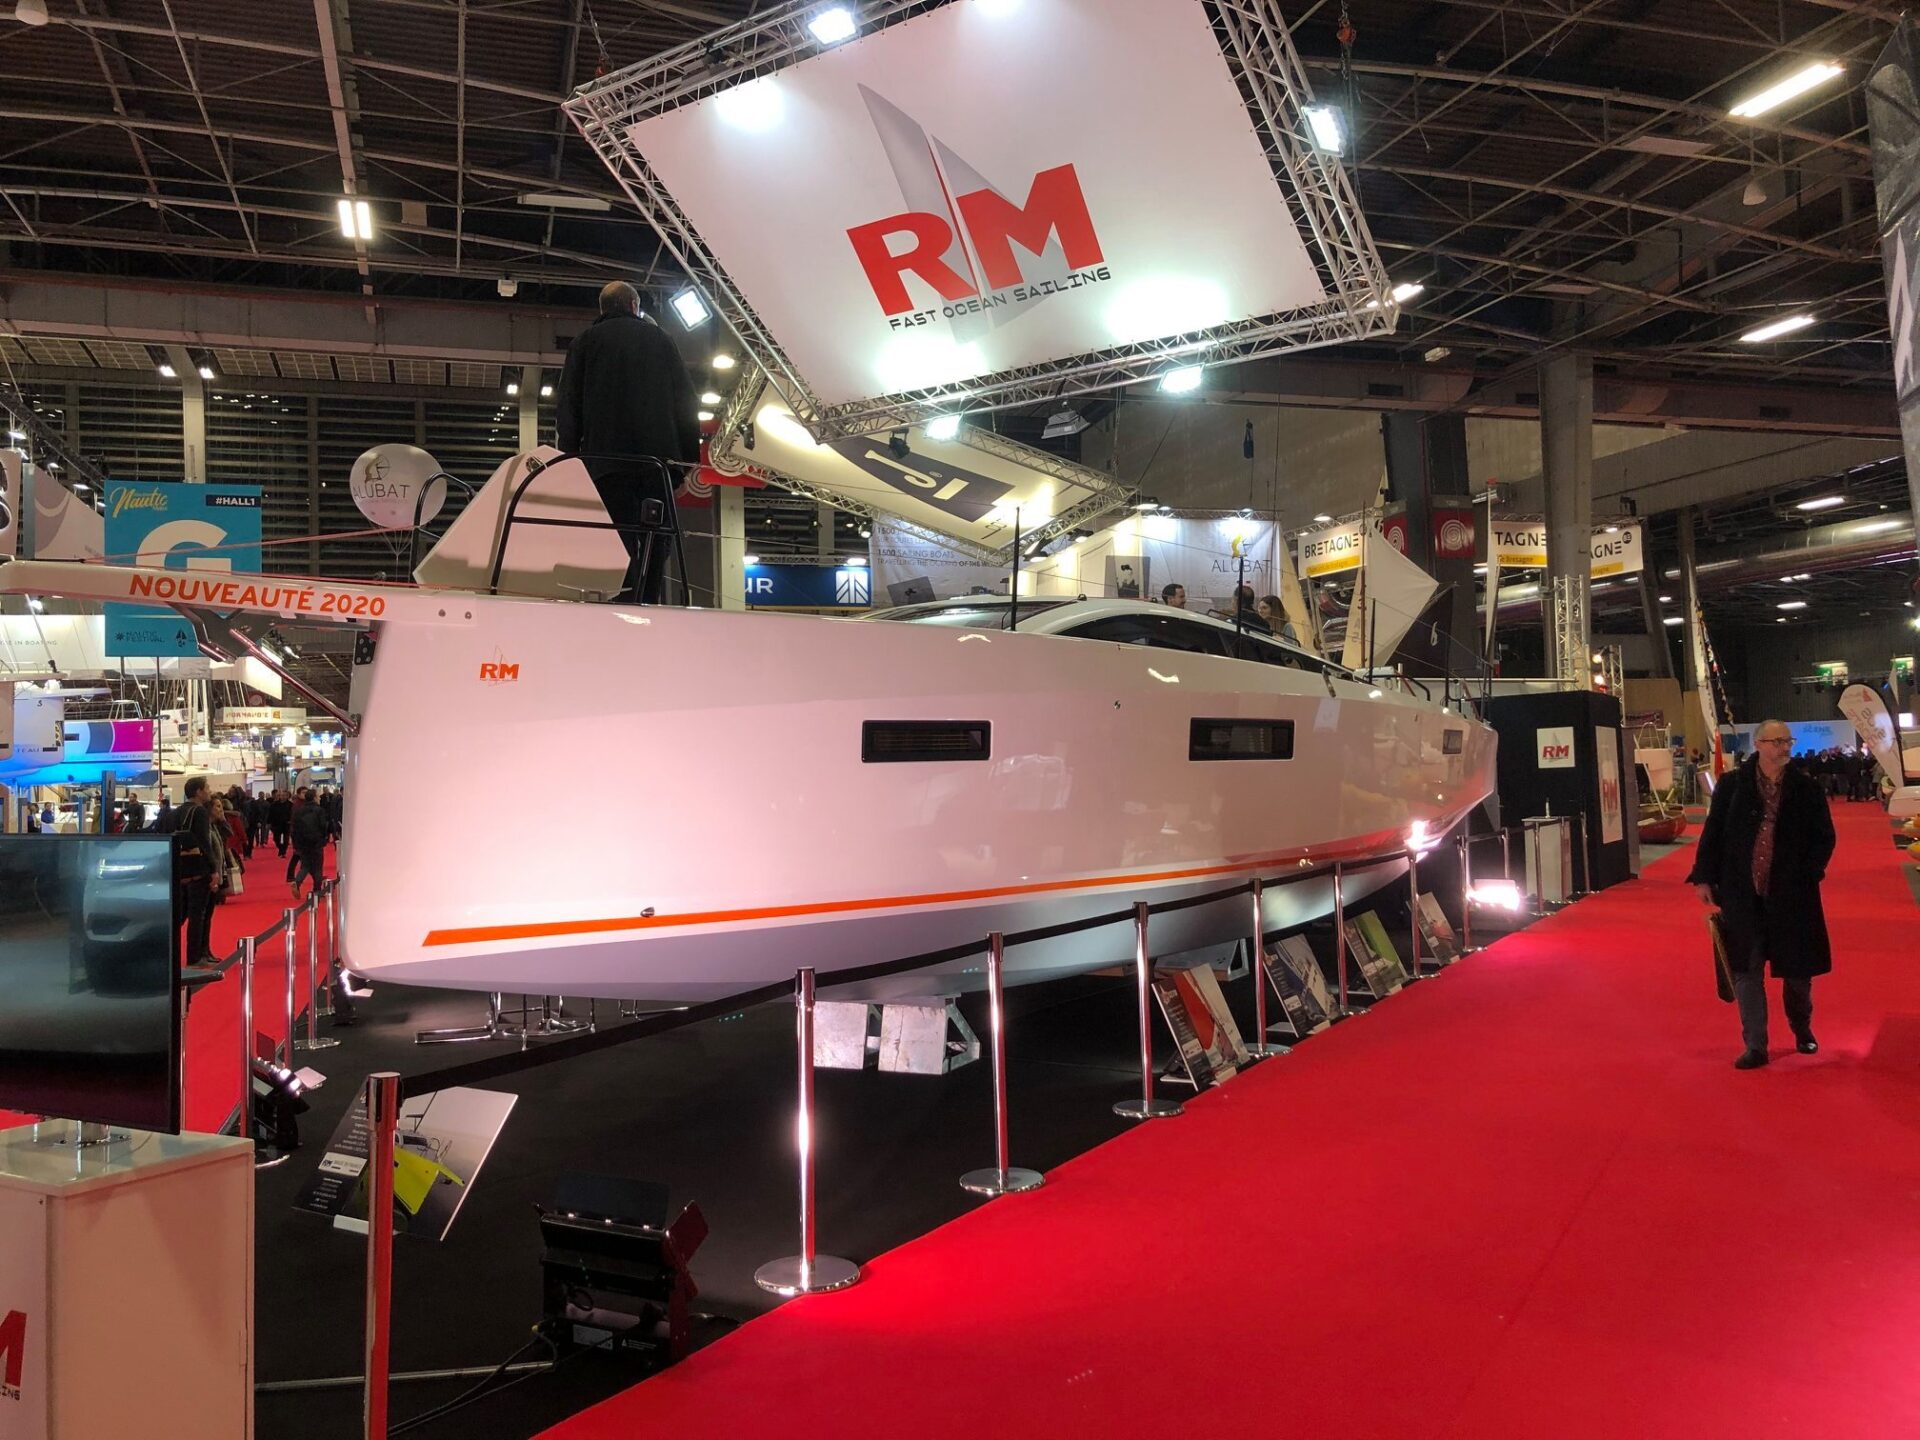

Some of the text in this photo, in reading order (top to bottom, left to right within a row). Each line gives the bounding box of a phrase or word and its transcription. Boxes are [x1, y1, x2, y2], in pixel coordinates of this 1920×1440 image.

[846, 163, 1105, 316] RM
[889, 267, 1112, 331] FAST OCEAN SAILING
[110, 486, 167, 518] Nautic
[215, 497, 256, 507] #HALL1
[1305, 533, 1359, 558] BRETAGNE
[1211, 559, 1272, 572] ALUBAT
[129, 574, 386, 617] NOUVEAUTÉ 2020
[480, 664, 520, 679] RM
[1542, 745, 1569, 758] RM
